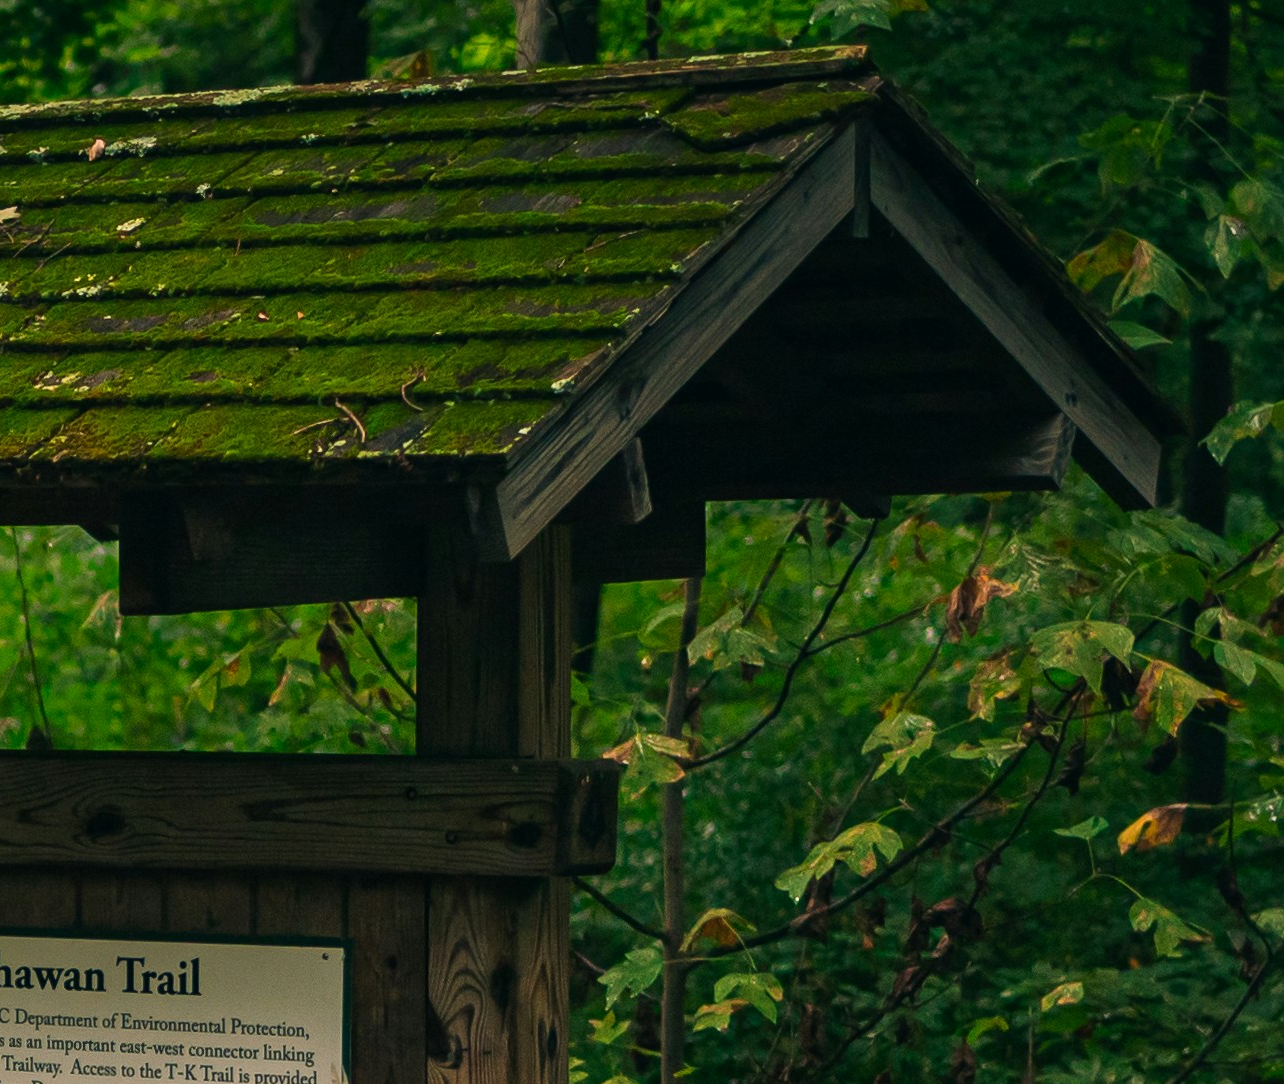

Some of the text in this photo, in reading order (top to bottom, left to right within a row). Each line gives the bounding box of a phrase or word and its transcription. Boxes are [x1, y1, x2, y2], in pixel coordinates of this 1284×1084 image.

[116, 956, 202, 996] Trail
[15, 1009, 99, 1031] Department
[102, 1014, 119, 1029] of
[121, 1014, 226, 1034] Environmental
[231, 1019, 310, 1041] Protection,
